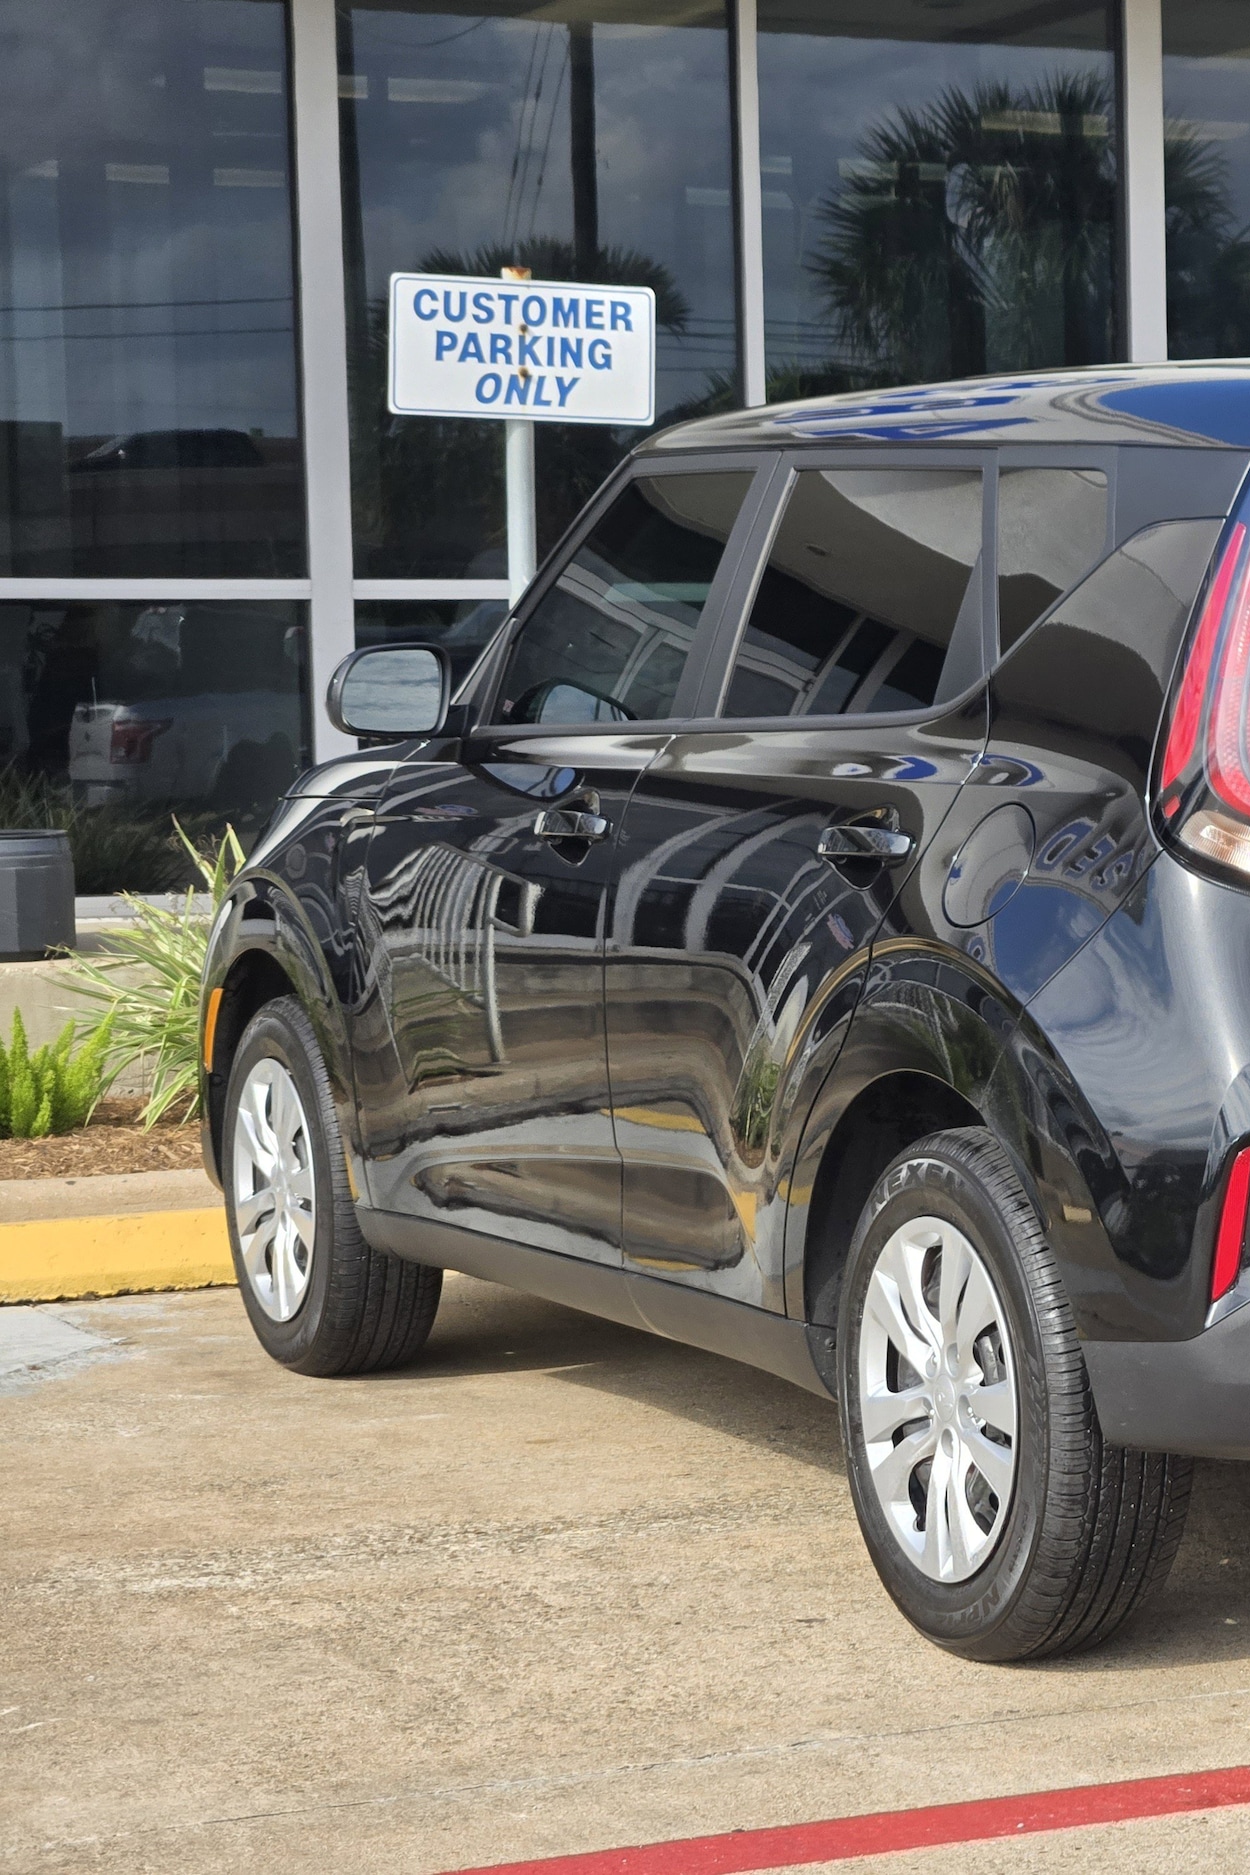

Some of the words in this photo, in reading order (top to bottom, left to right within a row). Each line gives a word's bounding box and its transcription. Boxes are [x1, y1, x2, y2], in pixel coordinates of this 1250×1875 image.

[413, 288, 634, 332] CUSTOMER
[434, 329, 613, 370] PARKING
[475, 371, 581, 407] ONLY
[870, 1162, 968, 1218] NEXEN
